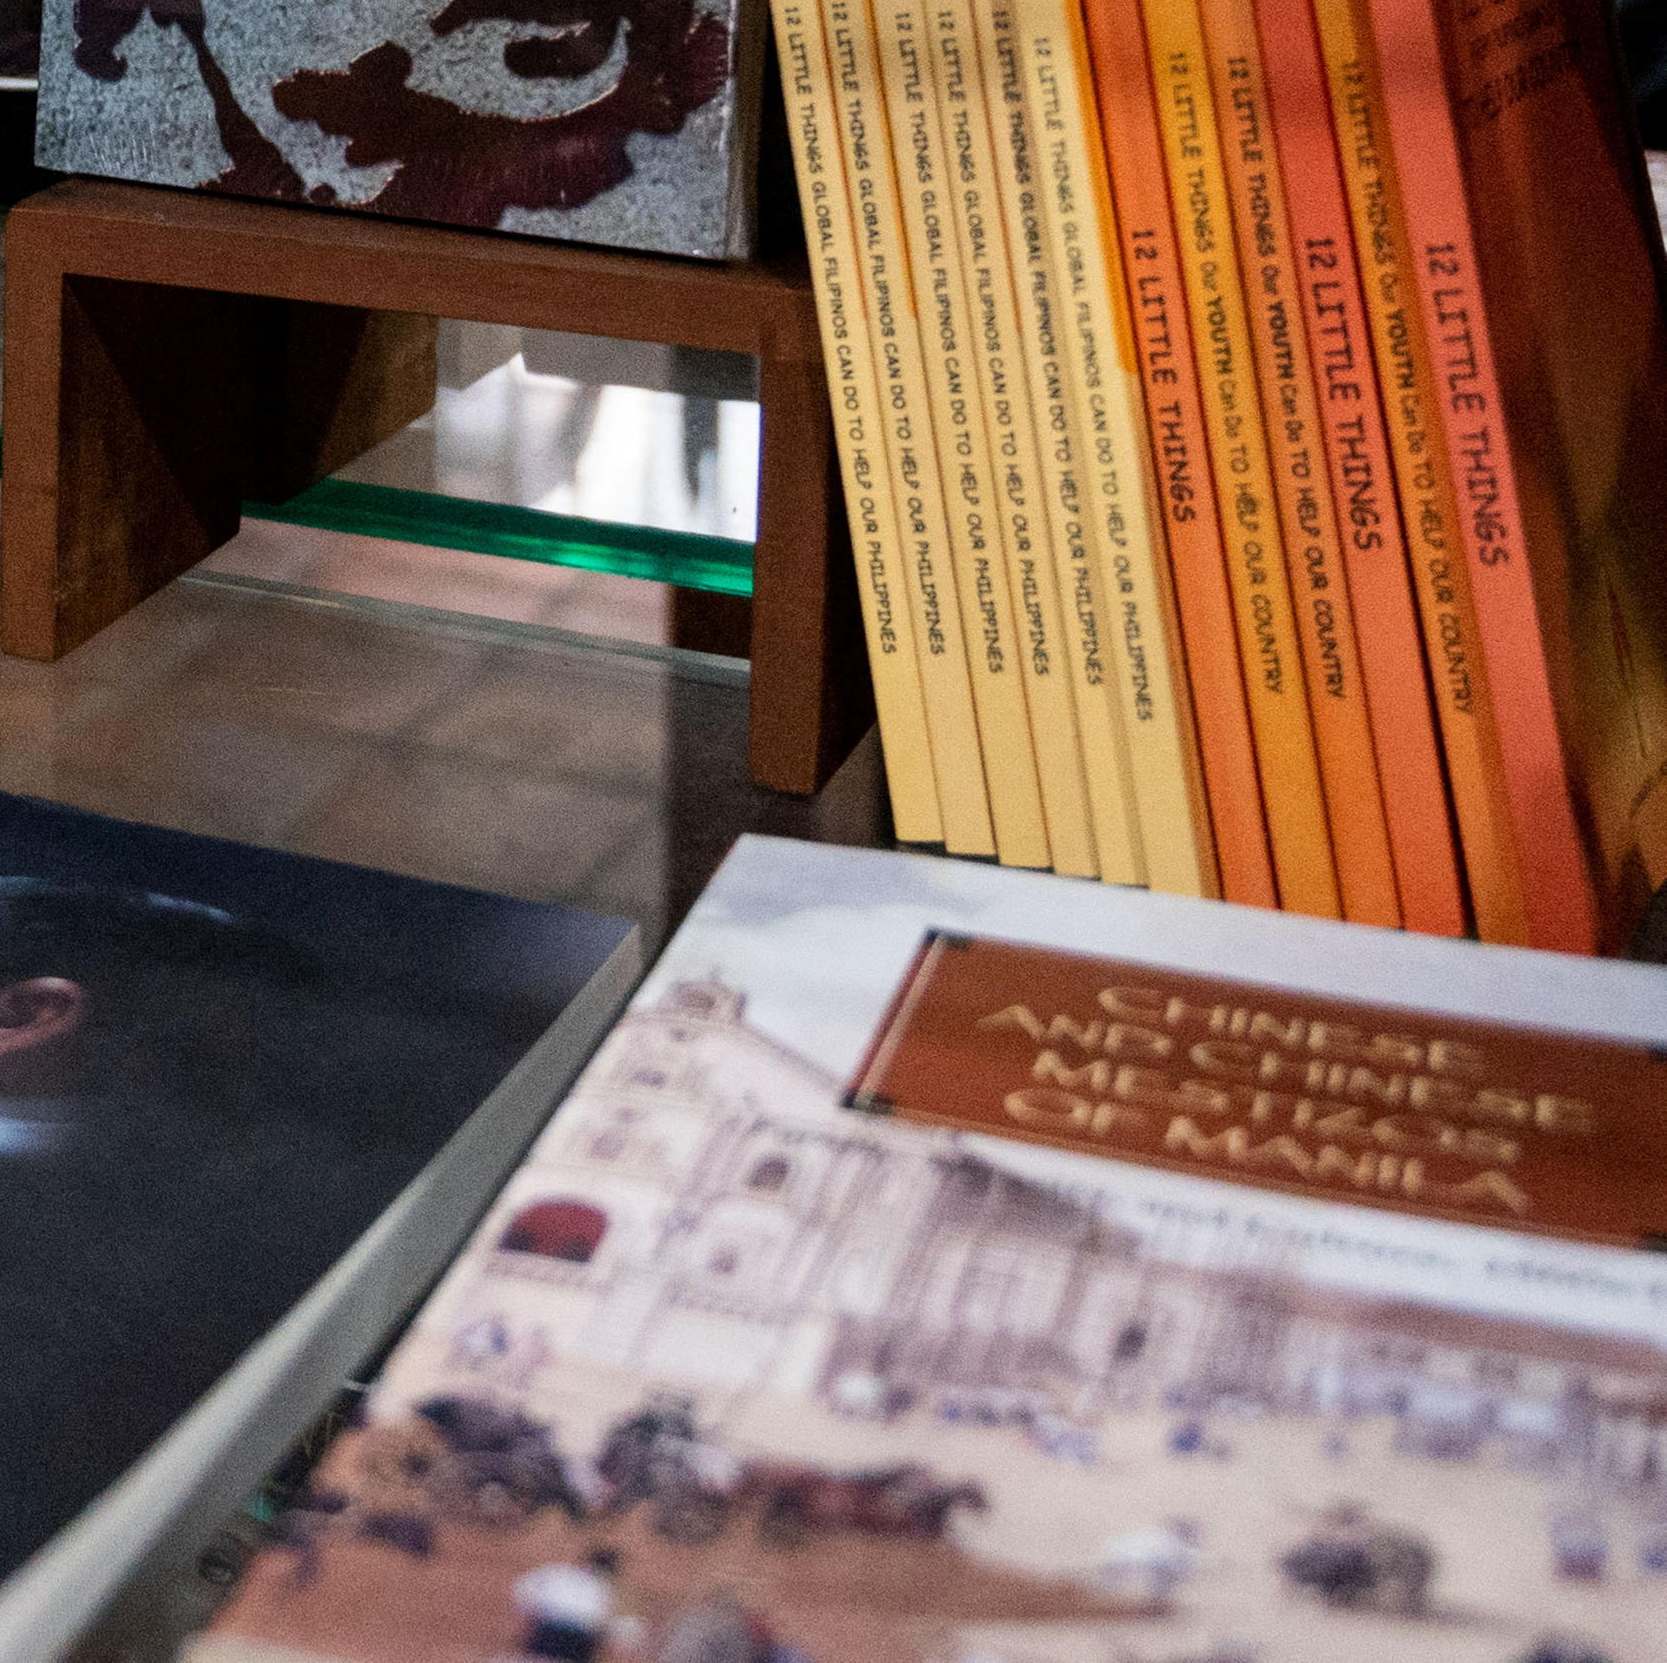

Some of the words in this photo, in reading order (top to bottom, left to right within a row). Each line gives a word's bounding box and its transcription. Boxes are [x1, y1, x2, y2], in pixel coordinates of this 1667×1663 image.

[784, 6, 803, 26] 12
[831, 1, 850, 21] 12
[788, 31, 813, 95] LITTLE
[835, 27, 861, 91] LITTLE
[1225, 56, 1249, 81] 12
[798, 103, 825, 174] THINGS
[845, 99, 872, 171] THINGS
[1230, 86, 1263, 164] LITTLE
[810, 180, 836, 250] GLOBAL
[857, 177, 884, 249] GLOBAL
[1130, 227, 1158, 262] 12
[1244, 172, 1277, 257] THINGS
[1258, 264, 1284, 296] Our
[1304, 235, 1339, 272] 12
[1424, 240, 1461, 279] 12
[821, 256, 849, 340] FILIPINOS
[868, 253, 897, 339] FILIPINOS
[834, 343, 855, 381] CAN
[881, 341, 903, 379] CAN
[1137, 274, 1177, 386] LITTLE
[1264, 300, 1297, 381] YOUTH
[1311, 278, 1360, 404] LITTLE
[1432, 284, 1485, 416] LITTLE
[840, 385, 860, 412] DO
[845, 415, 864, 442] TO
[887, 384, 908, 410] DO
[892, 414, 912, 440] TO
[1278, 383, 1303, 415] Can
[1156, 400, 1198, 523] THINGS
[1283, 418, 1307, 443] Do
[850, 447, 871, 490] HELP
[897, 446, 920, 490] HELP
[1288, 448, 1313, 479] TO
[1333, 414, 1384, 552] THINGS
[857, 496, 878, 534] OUR
[904, 495, 926, 534] OUR
[1294, 486, 1322, 537] HELP
[1456, 425, 1512, 569] THINGS
[863, 540, 896, 655] PHILIPPINES
[910, 540, 944, 655] PHILIPPINES
[1303, 544, 1331, 591] OUR
[1312, 596, 1349, 701] COUNTRY
[1097, 986, 1484, 1081] CHINESE
[978, 1004, 1175, 1058] AND
[1190, 1040, 1595, 1133] CHINESE
[1003, 1087, 1154, 1134] OF
[1166, 1116, 1531, 1216] MANILA
